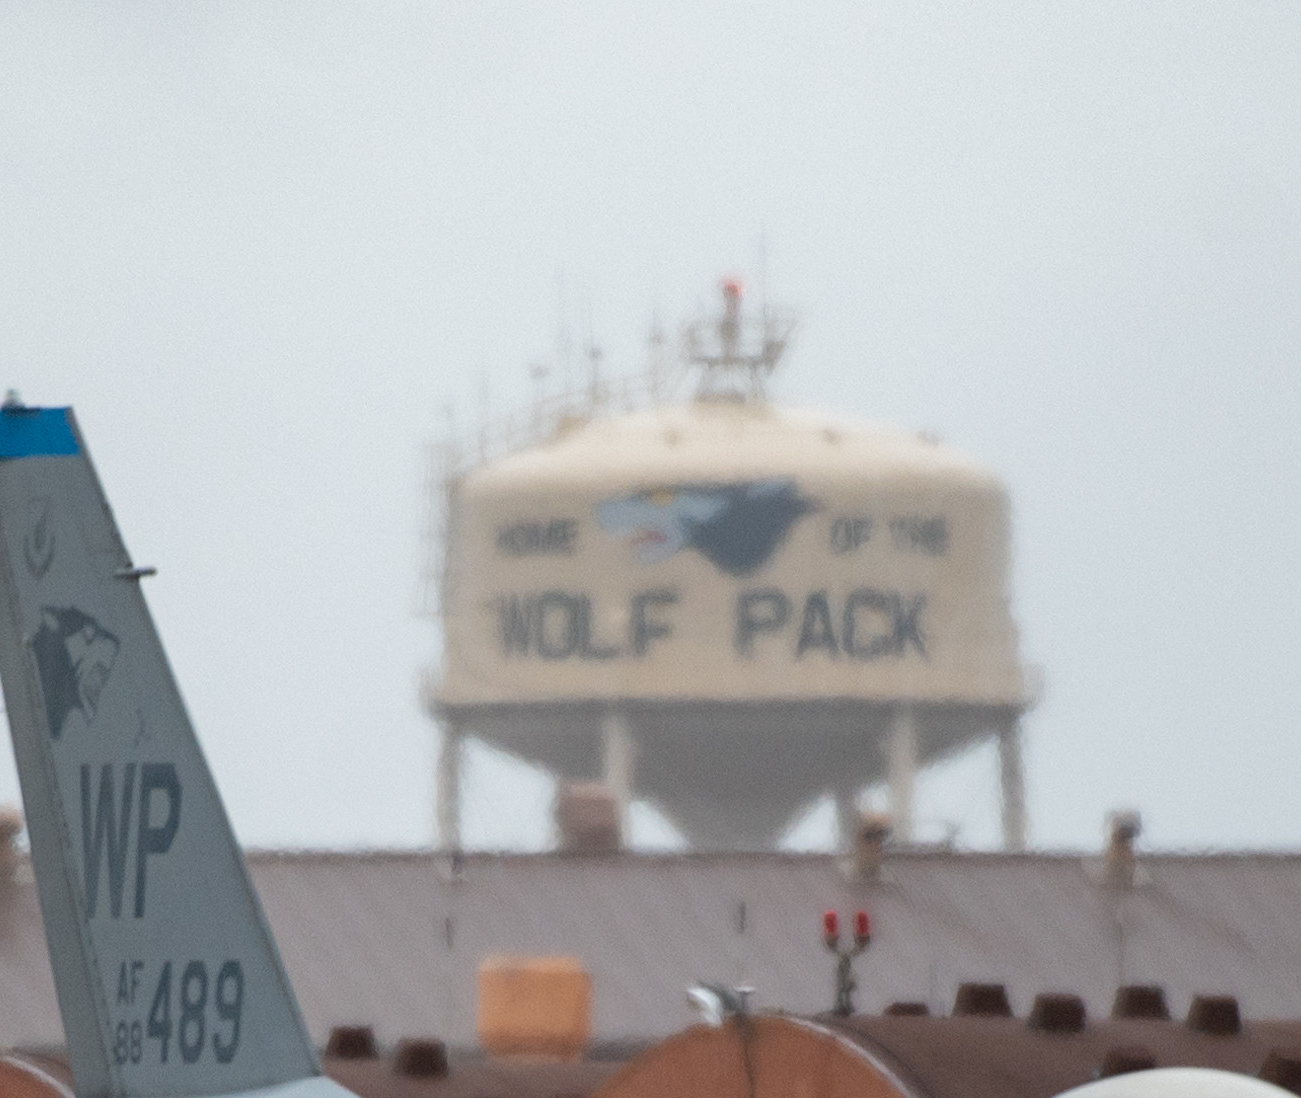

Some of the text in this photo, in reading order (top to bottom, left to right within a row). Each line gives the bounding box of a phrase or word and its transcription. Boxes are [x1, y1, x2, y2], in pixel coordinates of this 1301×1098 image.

[496, 517, 579, 557] HOME
[830, 515, 873, 555] OF
[497, 586, 928, 662] WOLF PACK
[79, 762, 184, 920] WP
[116, 960, 145, 1005] AF
[146, 959, 245, 1065] 489
[112, 1019, 143, 1066] 88
